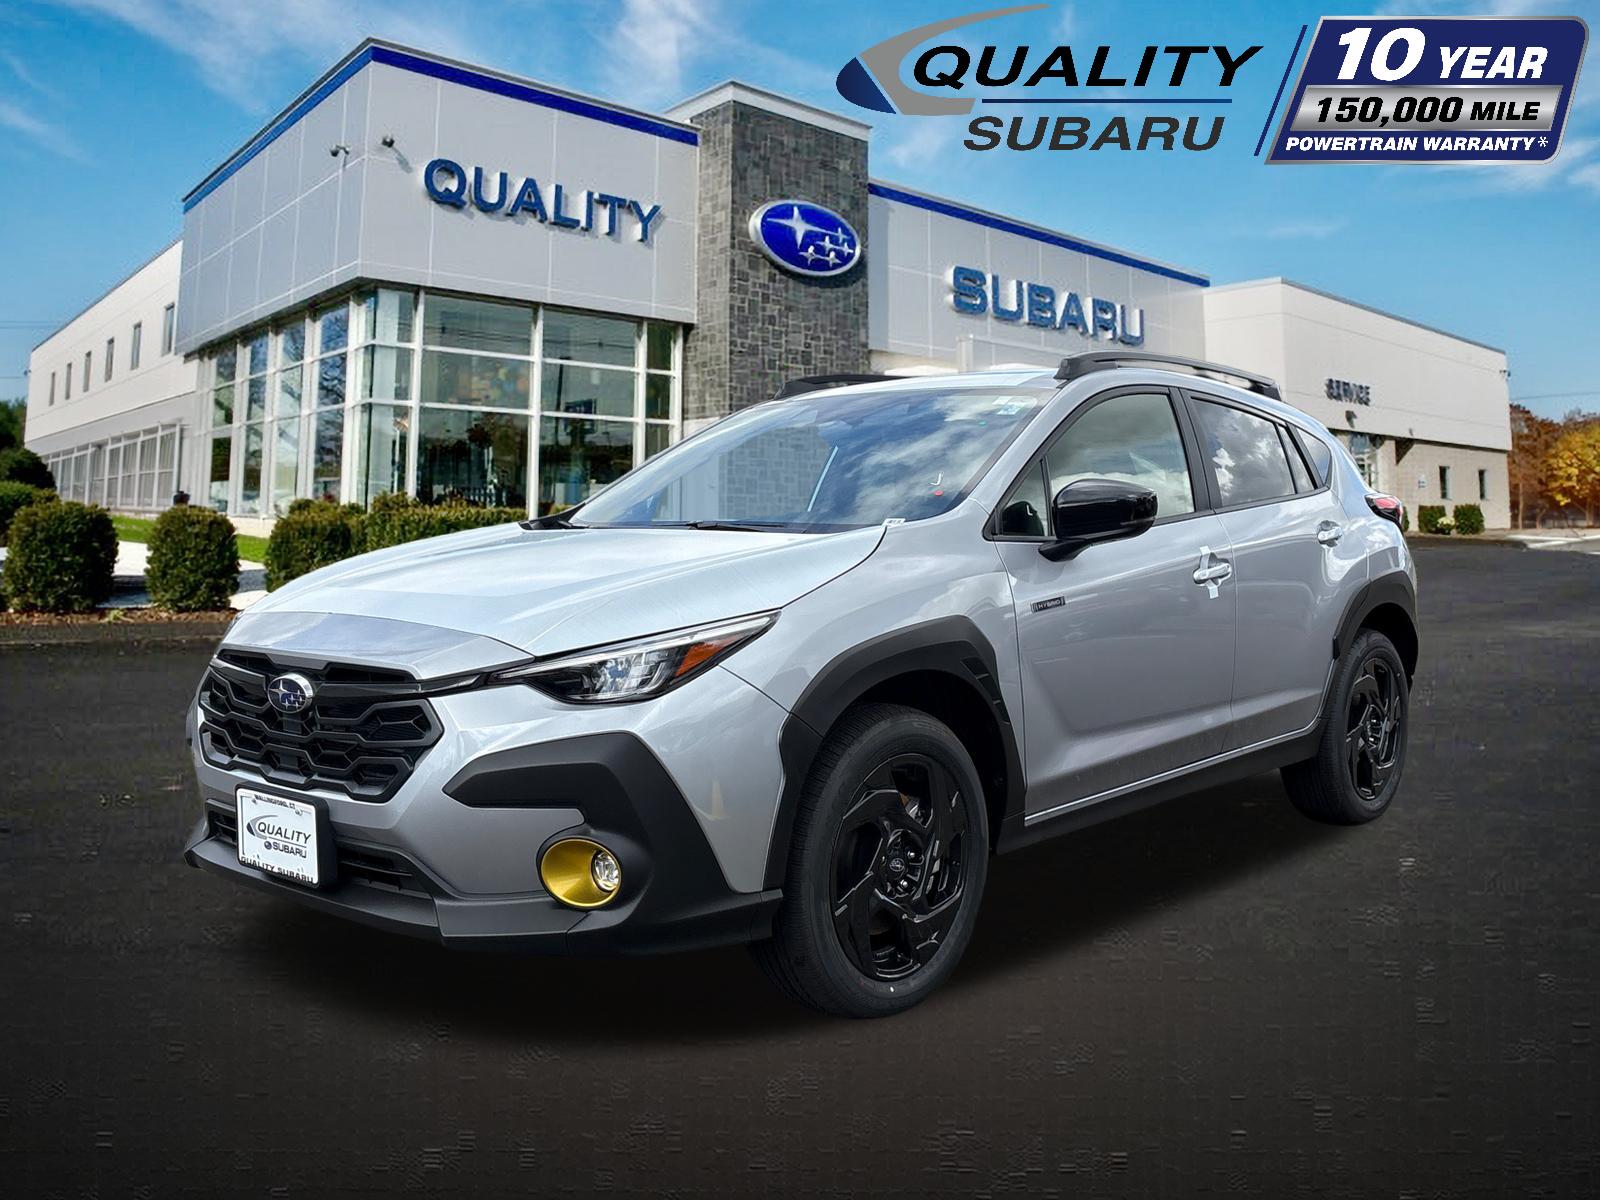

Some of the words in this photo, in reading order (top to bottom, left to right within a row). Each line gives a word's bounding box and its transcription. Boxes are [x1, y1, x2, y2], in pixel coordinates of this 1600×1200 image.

[424, 158, 662, 243] QUALITY
[950, 265, 1144, 346] SUBARU
[1325, 378, 1371, 407] SERVICE
[257, 821, 311, 844] QUALITY
[272, 841, 307, 859] SUBARU
[240, 856, 275, 872] QUALITY
[277, 866, 314, 883] SUBARU
